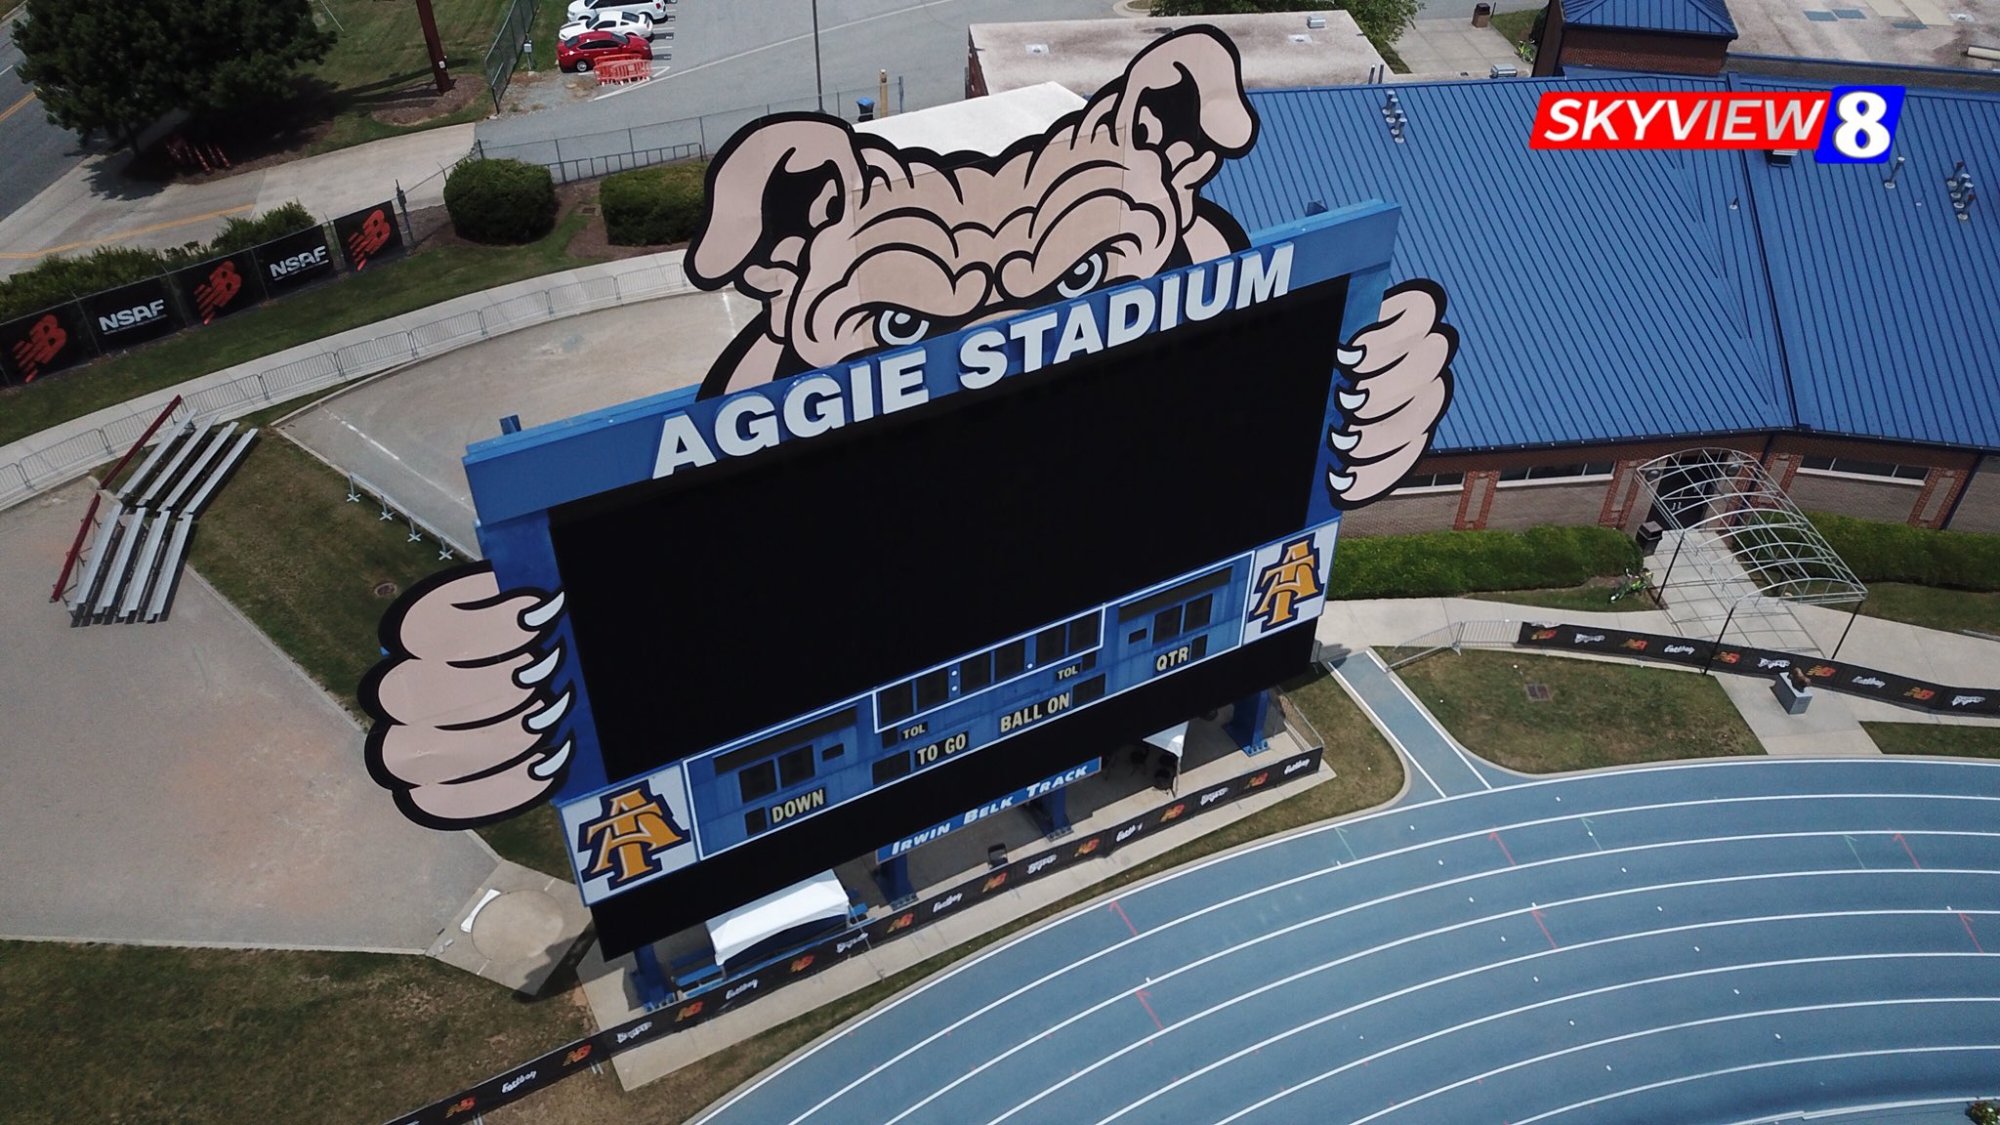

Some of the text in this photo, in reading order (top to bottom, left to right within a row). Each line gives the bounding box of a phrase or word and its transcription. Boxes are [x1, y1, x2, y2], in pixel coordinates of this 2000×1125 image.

[269, 245, 327, 279] NSAF
[98, 299, 165, 333] NSAF
[652, 242, 1295, 480] AGGIE STADIUM
[1057, 664, 1079, 681] TOL
[1156, 645, 1189, 673] QTR
[1000, 692, 1070, 733] BALL ON
[902, 724, 926, 740] TOL
[917, 733, 967, 766] TO GO
[771, 788, 825, 824] DOWN
